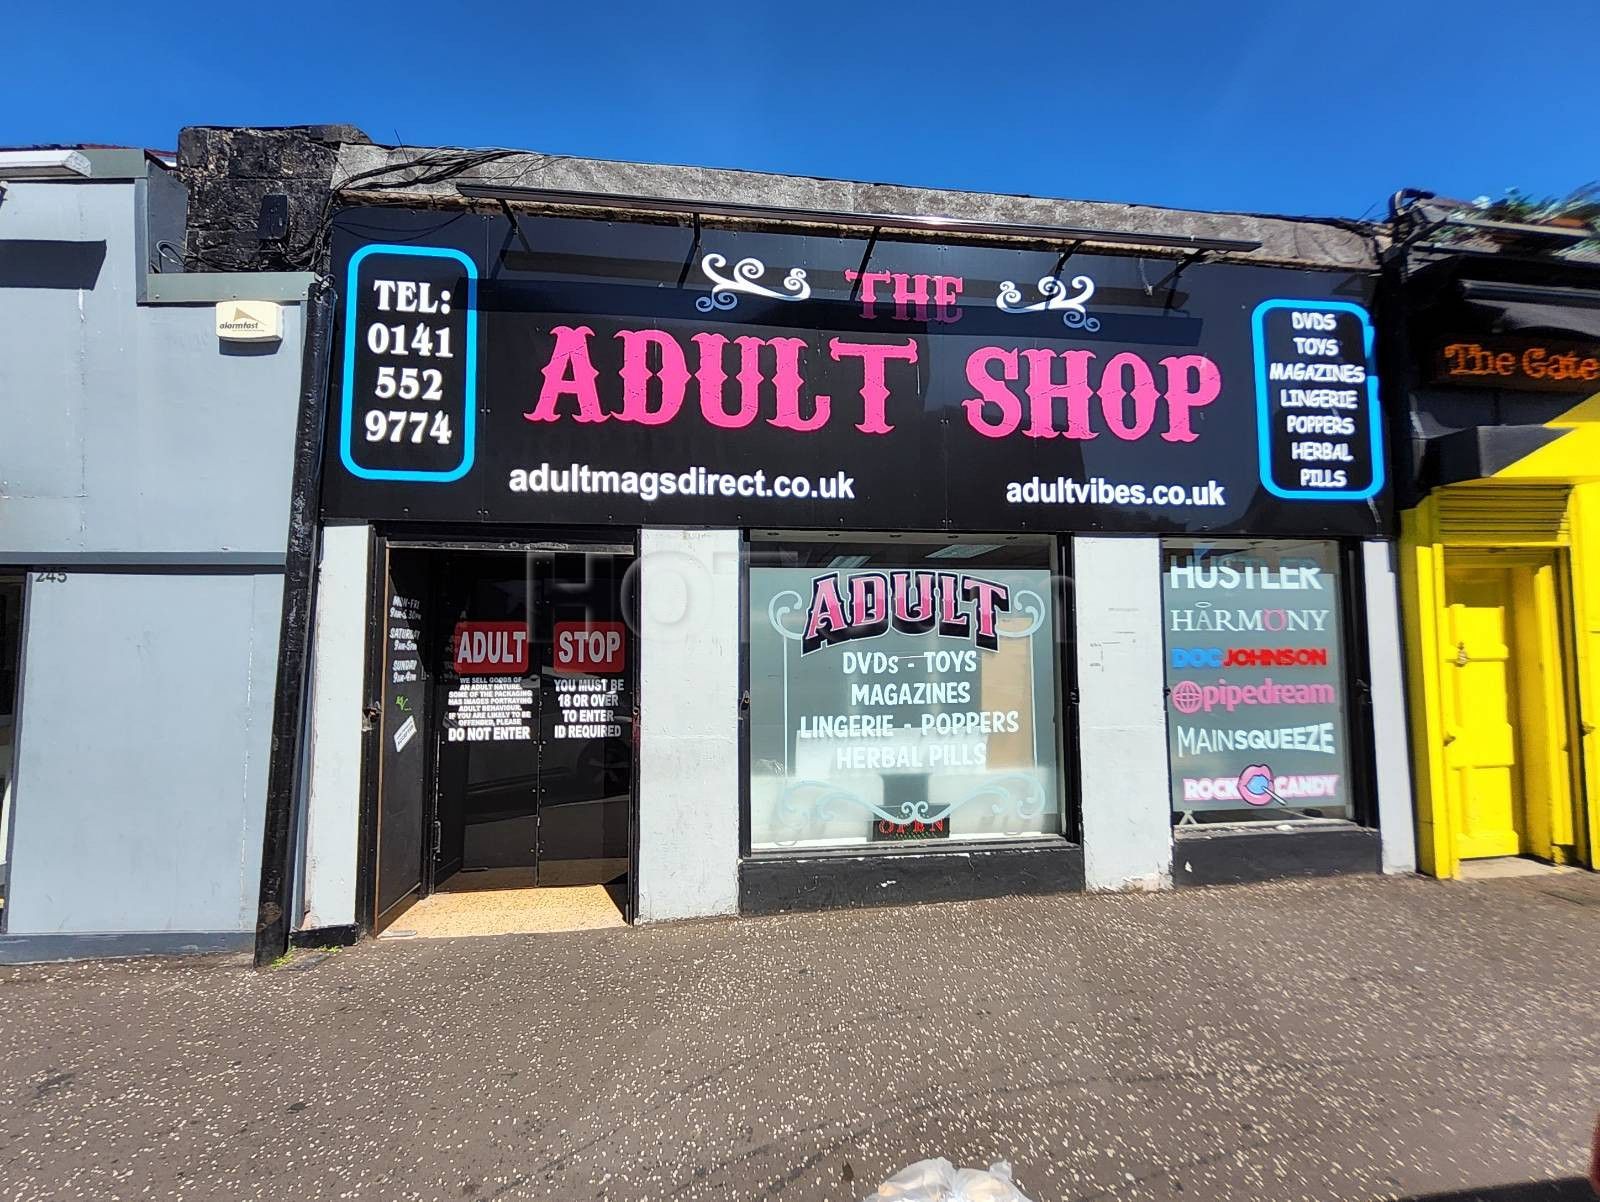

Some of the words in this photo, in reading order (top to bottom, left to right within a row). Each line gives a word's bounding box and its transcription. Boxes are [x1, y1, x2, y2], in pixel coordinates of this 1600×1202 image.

[373, 279, 452, 315] TEL:
[843, 269, 964, 323] THE
[219, 321, 259, 329] alarmfast
[1291, 311, 1338, 332] DVDS
[366, 322, 454, 358] 0141
[1293, 336, 1340, 357] TOYS
[1444, 343, 1515, 375] The
[374, 366, 444, 401] 552
[523, 325, 918, 435] ADULT
[961, 346, 1222, 443] SHOP
[1269, 362, 1366, 384] MAGAZINES
[1280, 388, 1359, 410] LINGERIE
[364, 409, 452, 445] 9774
[1286, 414, 1356, 436] POPPERS
[1291, 441, 1355, 463] HERBAL
[508, 462, 855, 501] adultmagsdirect.co.uk
[1300, 467, 1348, 488] PILLS
[1005, 475, 1226, 507] adultvibes.co.uk
[1170, 555, 1323, 590] HUSTLER
[800, 570, 1012, 658] ADULT
[457, 631, 526, 663] ADULT
[559, 630, 621, 663] STOP
[1171, 648, 1222, 669] DOC
[1223, 648, 1328, 668] JOHNSON
[842, 651, 899, 674] DVDs
[924, 650, 977, 673] TOYS
[554, 679, 576, 692] YOU
[578, 679, 608, 692] MUST
[610, 679, 624, 691] BE
[851, 682, 970, 706] MAGAZINES
[1202, 677, 1335, 712] pipedream
[558, 694, 571, 707] 18
[573, 694, 588, 707] OR
[591, 694, 619, 707] OVER
[562, 710, 577, 722] TO
[580, 710, 614, 722] ENTER
[799, 714, 894, 739] LINGERIE
[921, 711, 1019, 736] POPPERS
[448, 728, 465, 741] DO
[467, 727, 491, 741] NOT
[493, 727, 531, 740] ENTER
[554, 725, 566, 738] ID
[568, 725, 621, 738] REQUIRED
[837, 746, 923, 769] HERBAL
[929, 743, 986, 766] PILLS
[1183, 777, 1240, 800] ROCK
[1273, 775, 1338, 796] CANDY
